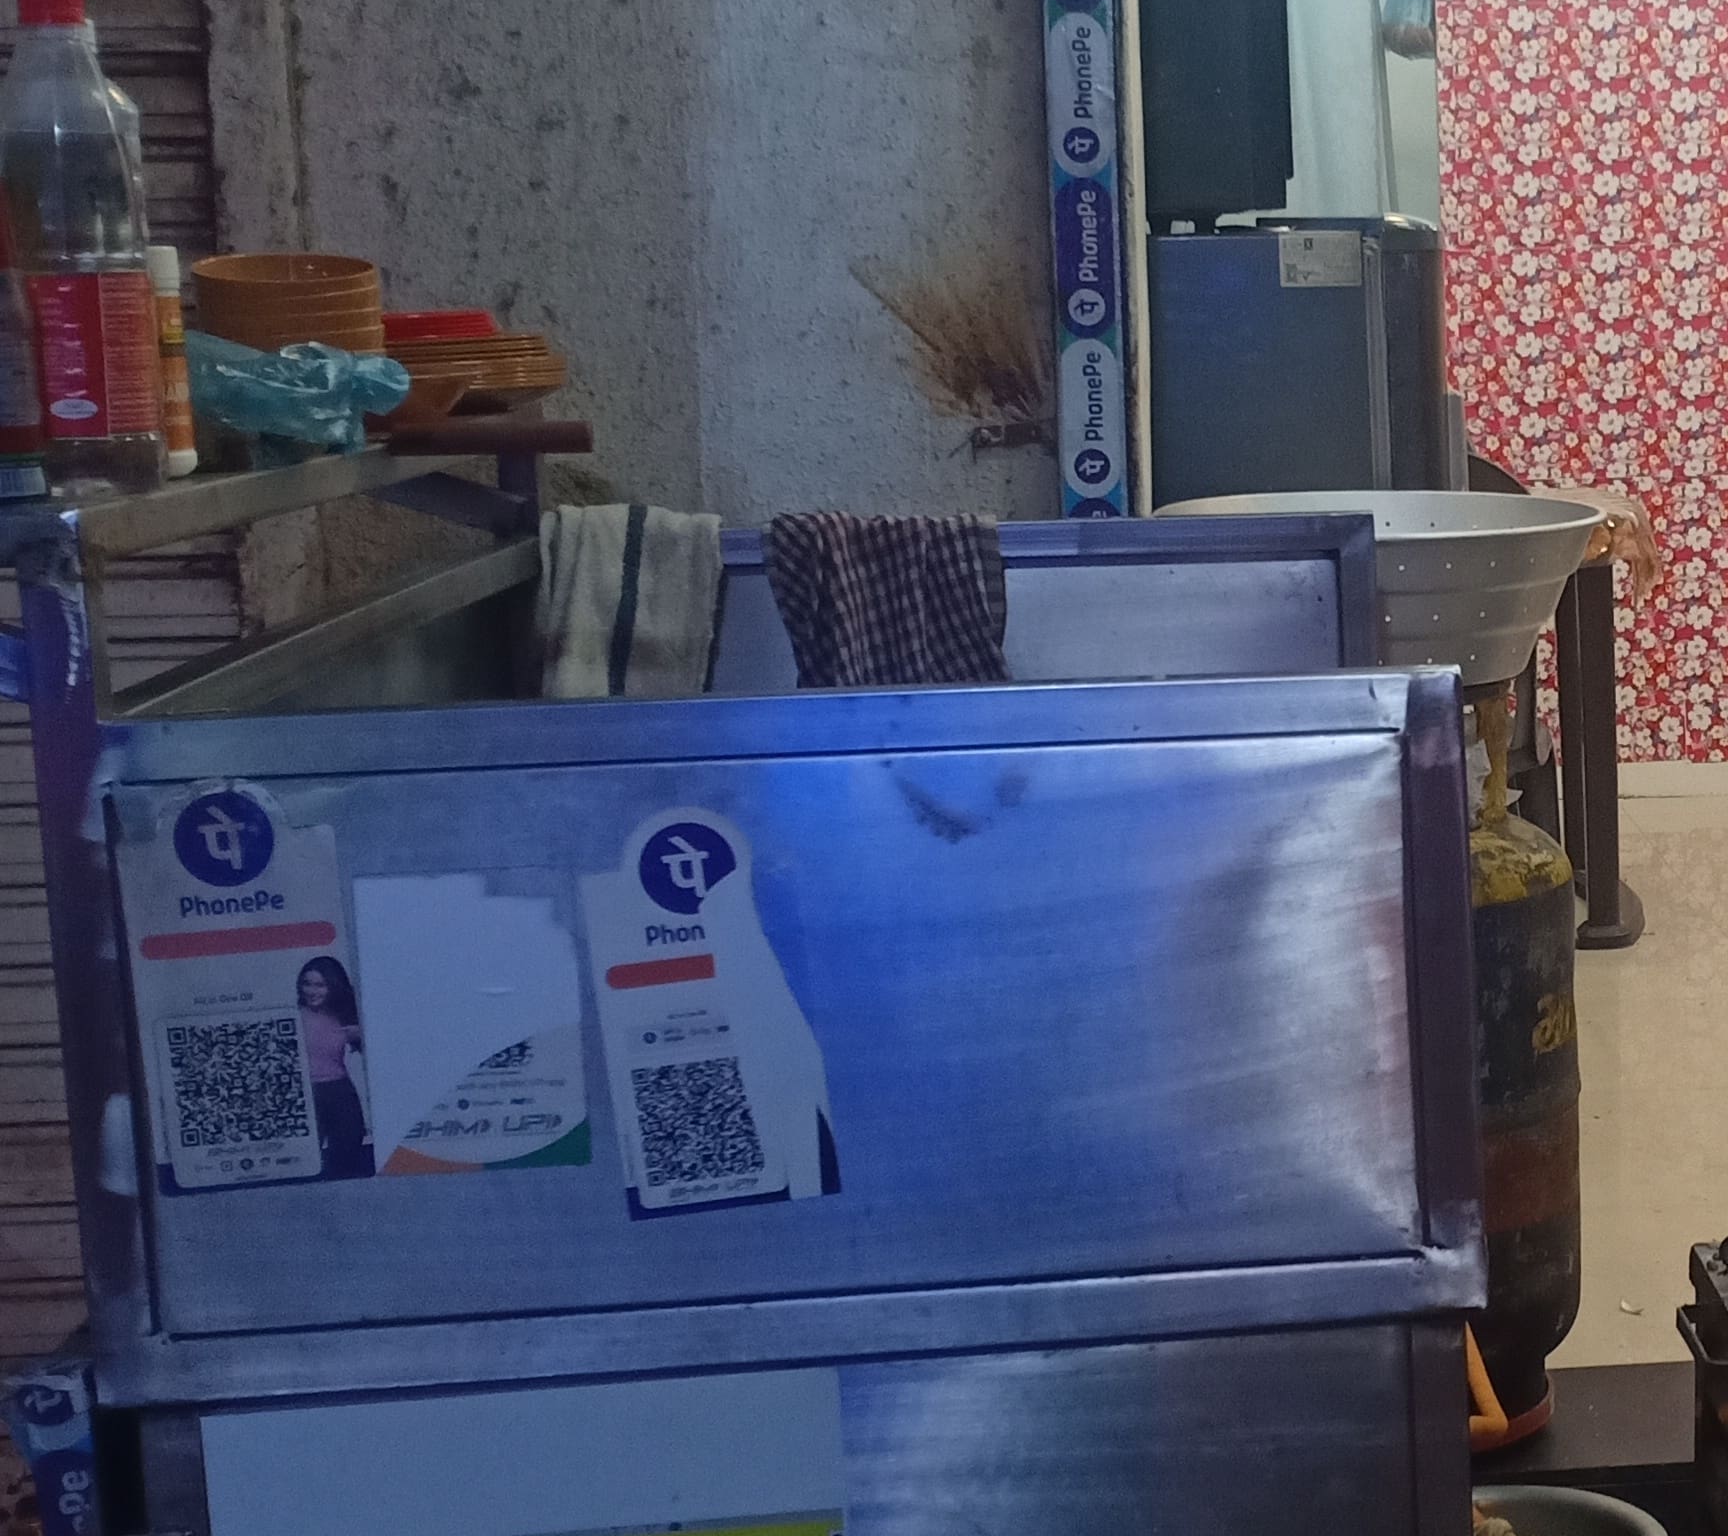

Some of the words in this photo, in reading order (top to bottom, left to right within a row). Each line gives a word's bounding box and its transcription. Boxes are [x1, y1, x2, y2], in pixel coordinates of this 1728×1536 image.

[1072, 27, 1093, 119] PhonePe
[1078, 189, 1100, 282] PhonePe
[1083, 350, 1104, 442] PhonePe
[180, 890, 285, 918] PhonePe
